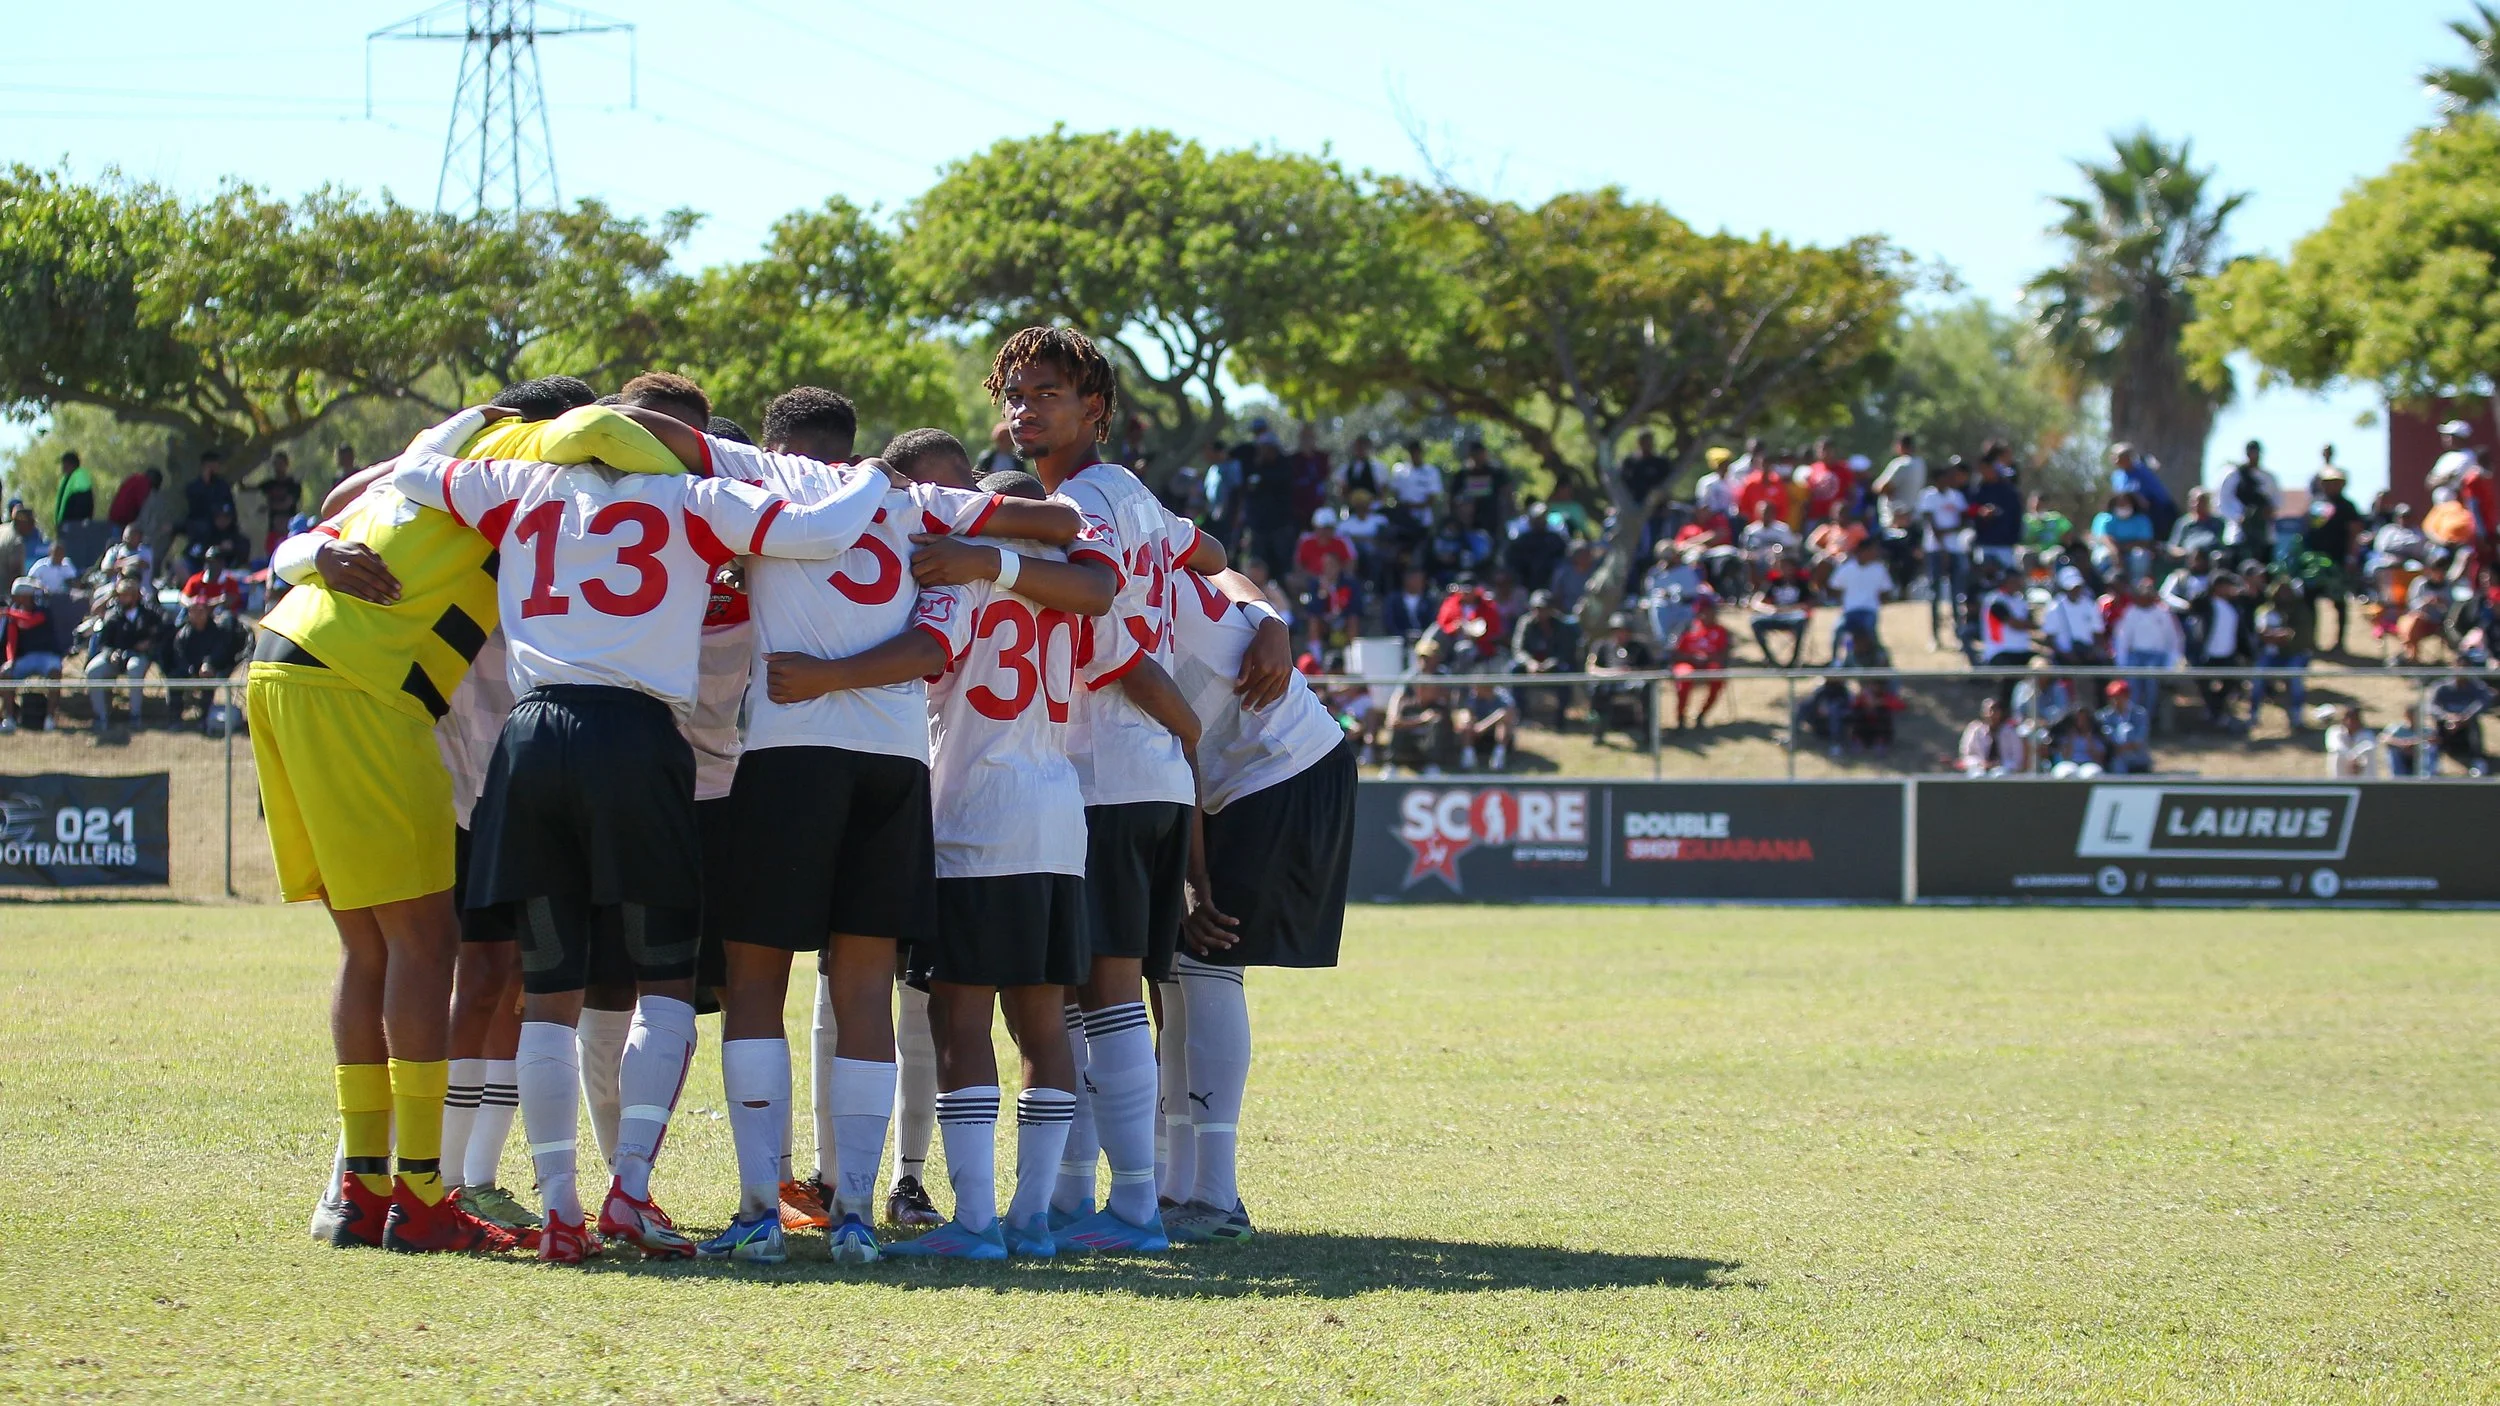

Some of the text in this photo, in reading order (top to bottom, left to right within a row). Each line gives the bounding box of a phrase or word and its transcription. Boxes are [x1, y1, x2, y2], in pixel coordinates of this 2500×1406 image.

[514, 500, 670, 619] 13
[966, 600, 1079, 723] 30
[56, 807, 135, 843] 021
[1401, 789, 1588, 843] SCORE
[1624, 813, 1730, 838] DOUBLE
[2165, 806, 2333, 838] LAURUS
[0, 842, 137, 866] OTBALLERS
